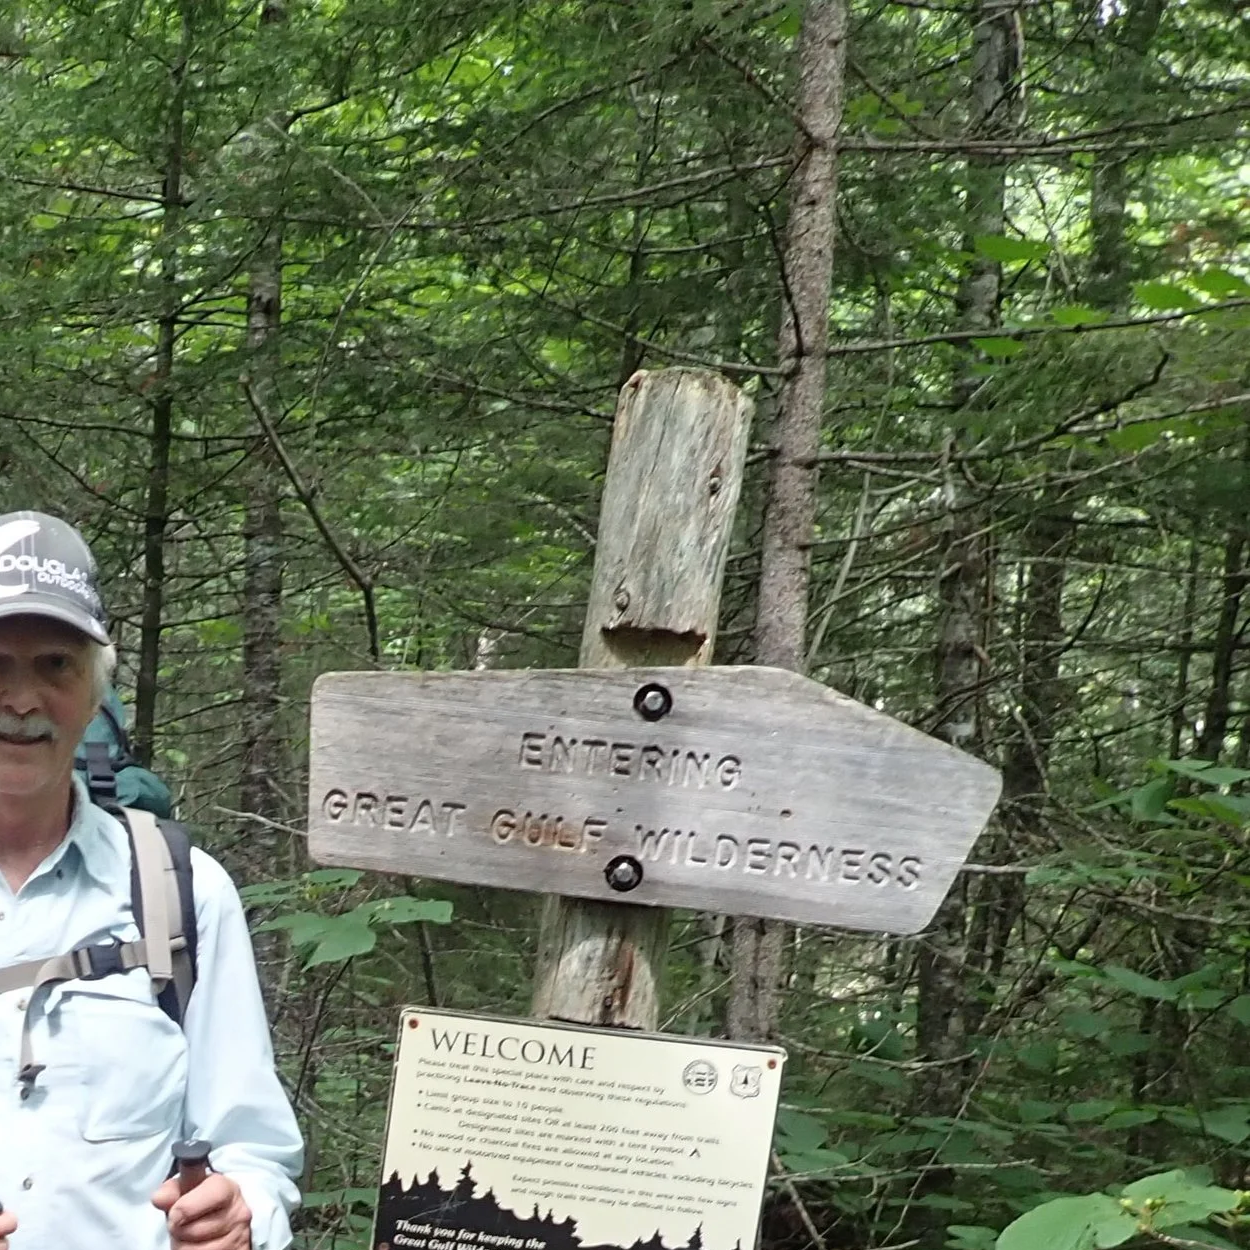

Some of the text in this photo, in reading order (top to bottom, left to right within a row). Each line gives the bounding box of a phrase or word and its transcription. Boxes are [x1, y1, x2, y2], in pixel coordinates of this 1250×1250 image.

[520, 732, 743, 792] ENTERING
[321, 787, 927, 892] GREAT GULF WILDERNESS
[431, 1028, 595, 1070] WELCOME
[393, 1233, 426, 1248] Great
[395, 1219, 546, 1249] Thank you for keeping the
